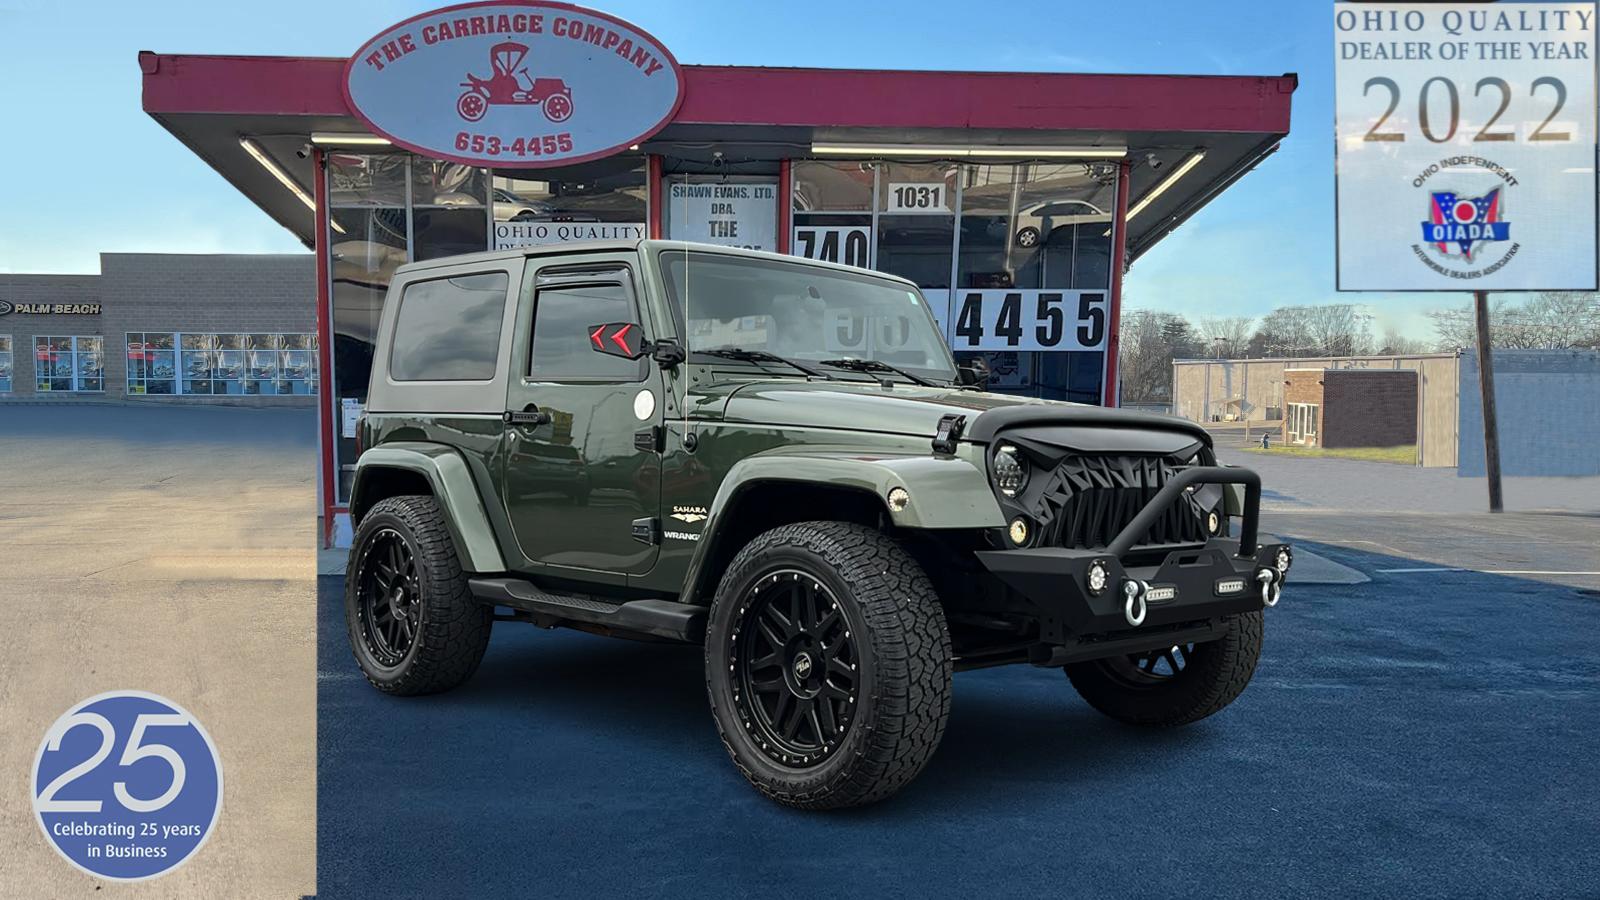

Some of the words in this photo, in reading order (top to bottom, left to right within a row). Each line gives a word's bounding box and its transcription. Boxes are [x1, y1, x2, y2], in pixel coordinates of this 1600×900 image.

[1336, 10, 1425, 31] OHIO
[1442, 10, 1593, 35] QUALITY
[366, 34, 416, 71] THE
[422, 14, 544, 45] CARRIAGE
[552, 17, 664, 77] COMPANY
[1340, 42, 1433, 60] DEALER
[1439, 42, 1469, 60] OF
[1475, 42, 1522, 60] THE
[1528, 42, 1589, 60] YEAR
[1363, 76, 1571, 143] 2022
[455, 132, 573, 157] 653-4455
[1412, 163, 1439, 188] OHIO
[1440, 155, 1519, 187] INDEPENDENT
[673, 186, 711, 198] SHAWN
[894, 186, 941, 209] 1031
[497, 226, 548, 239] OHIO
[557, 226, 644, 240] QUALITY
[708, 221, 738, 238] THE
[1433, 224, 1495, 240] OIADA
[1411, 244, 1450, 276] AUTOMOBILE
[1450, 269, 1482, 280] DEALERS
[1482, 242, 1520, 276] ASSOCIATION
[14, 303, 50, 314] PALM
[955, 293, 1105, 346] 4455
[673, 505, 707, 514] SAHARA
